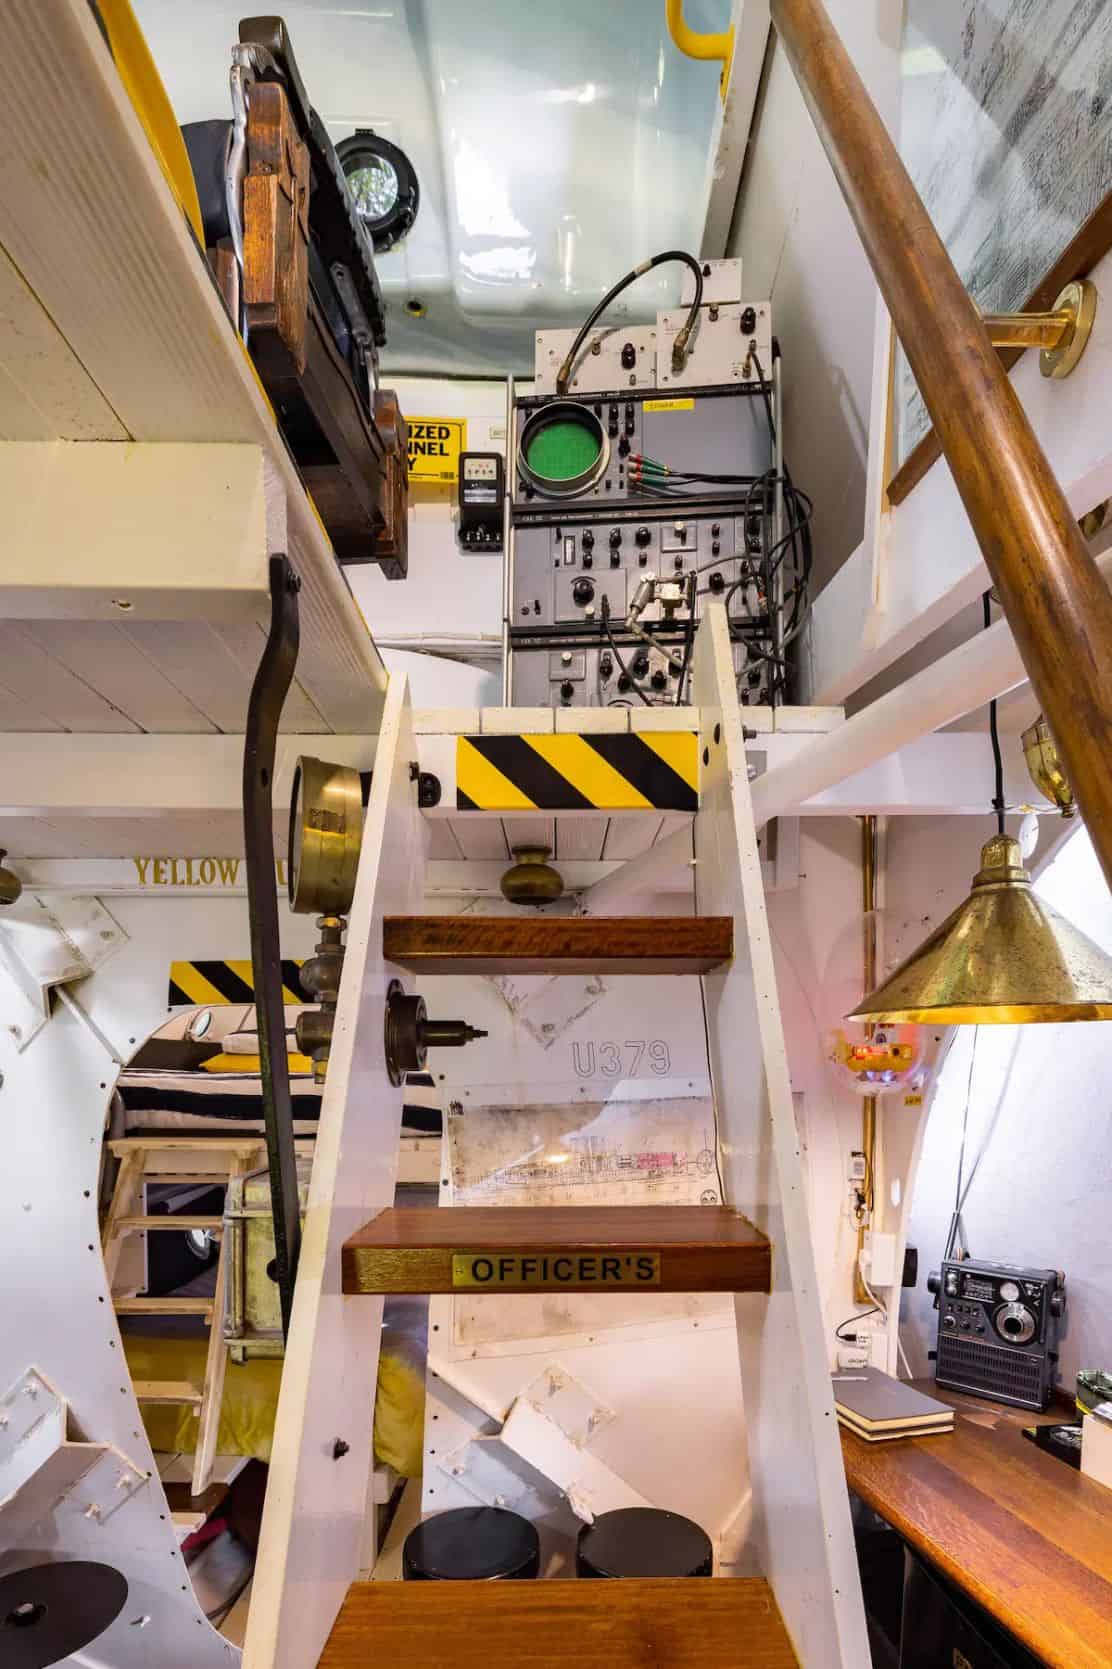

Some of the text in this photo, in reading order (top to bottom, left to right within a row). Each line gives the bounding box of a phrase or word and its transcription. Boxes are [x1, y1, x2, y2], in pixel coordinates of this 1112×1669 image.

[407, 425, 450, 440] IZED
[133, 856, 240, 886] YELLOW
[572, 1039, 671, 1078] U379
[471, 1257, 654, 1282] OFFICER'S
